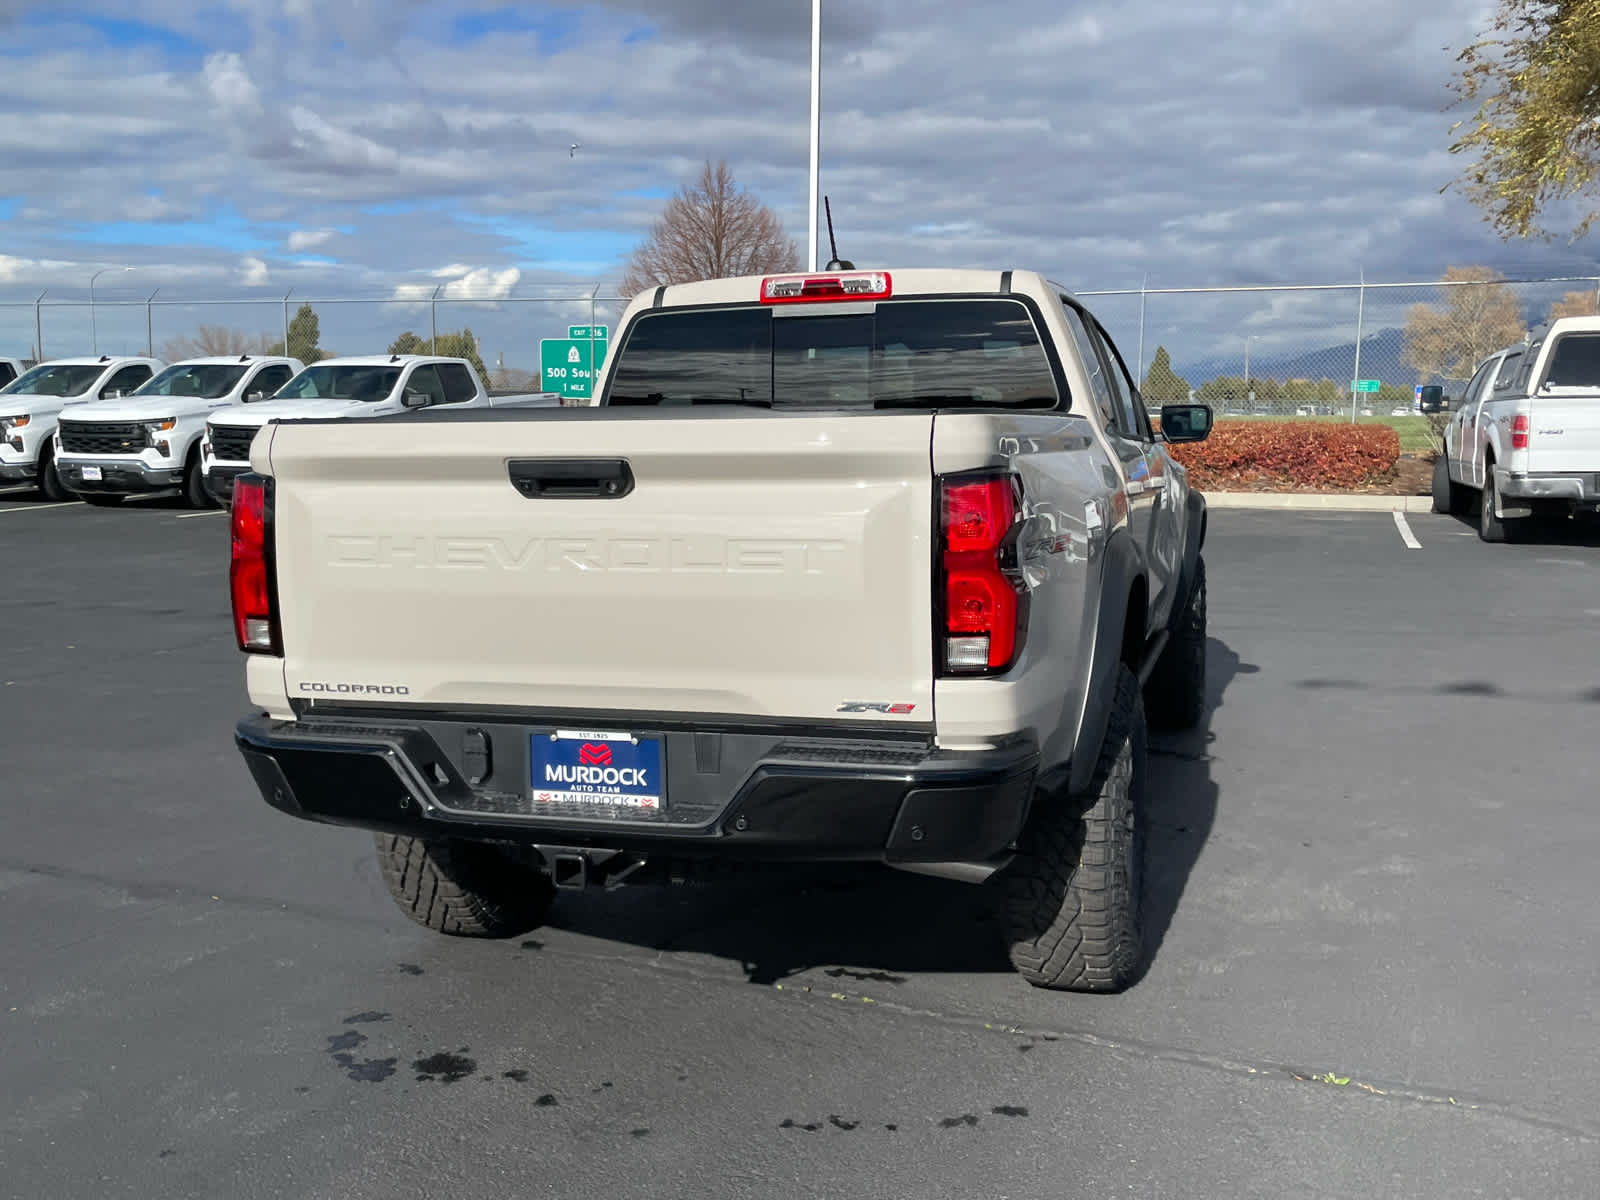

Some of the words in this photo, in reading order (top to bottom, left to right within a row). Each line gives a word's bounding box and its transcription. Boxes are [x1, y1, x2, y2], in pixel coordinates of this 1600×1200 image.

[547, 367, 567, 378] 500
[572, 367, 601, 378] Souh
[563, 383, 567, 392] 1
[570, 383, 585, 391] MILE
[327, 534, 846, 575] CHEVROLET
[299, 682, 409, 695] COLORADO
[545, 763, 648, 787] MURDOCK
[570, 784, 593, 792] AUTO
[597, 785, 620, 793] TEAM
[562, 792, 631, 806] MURDOCK
